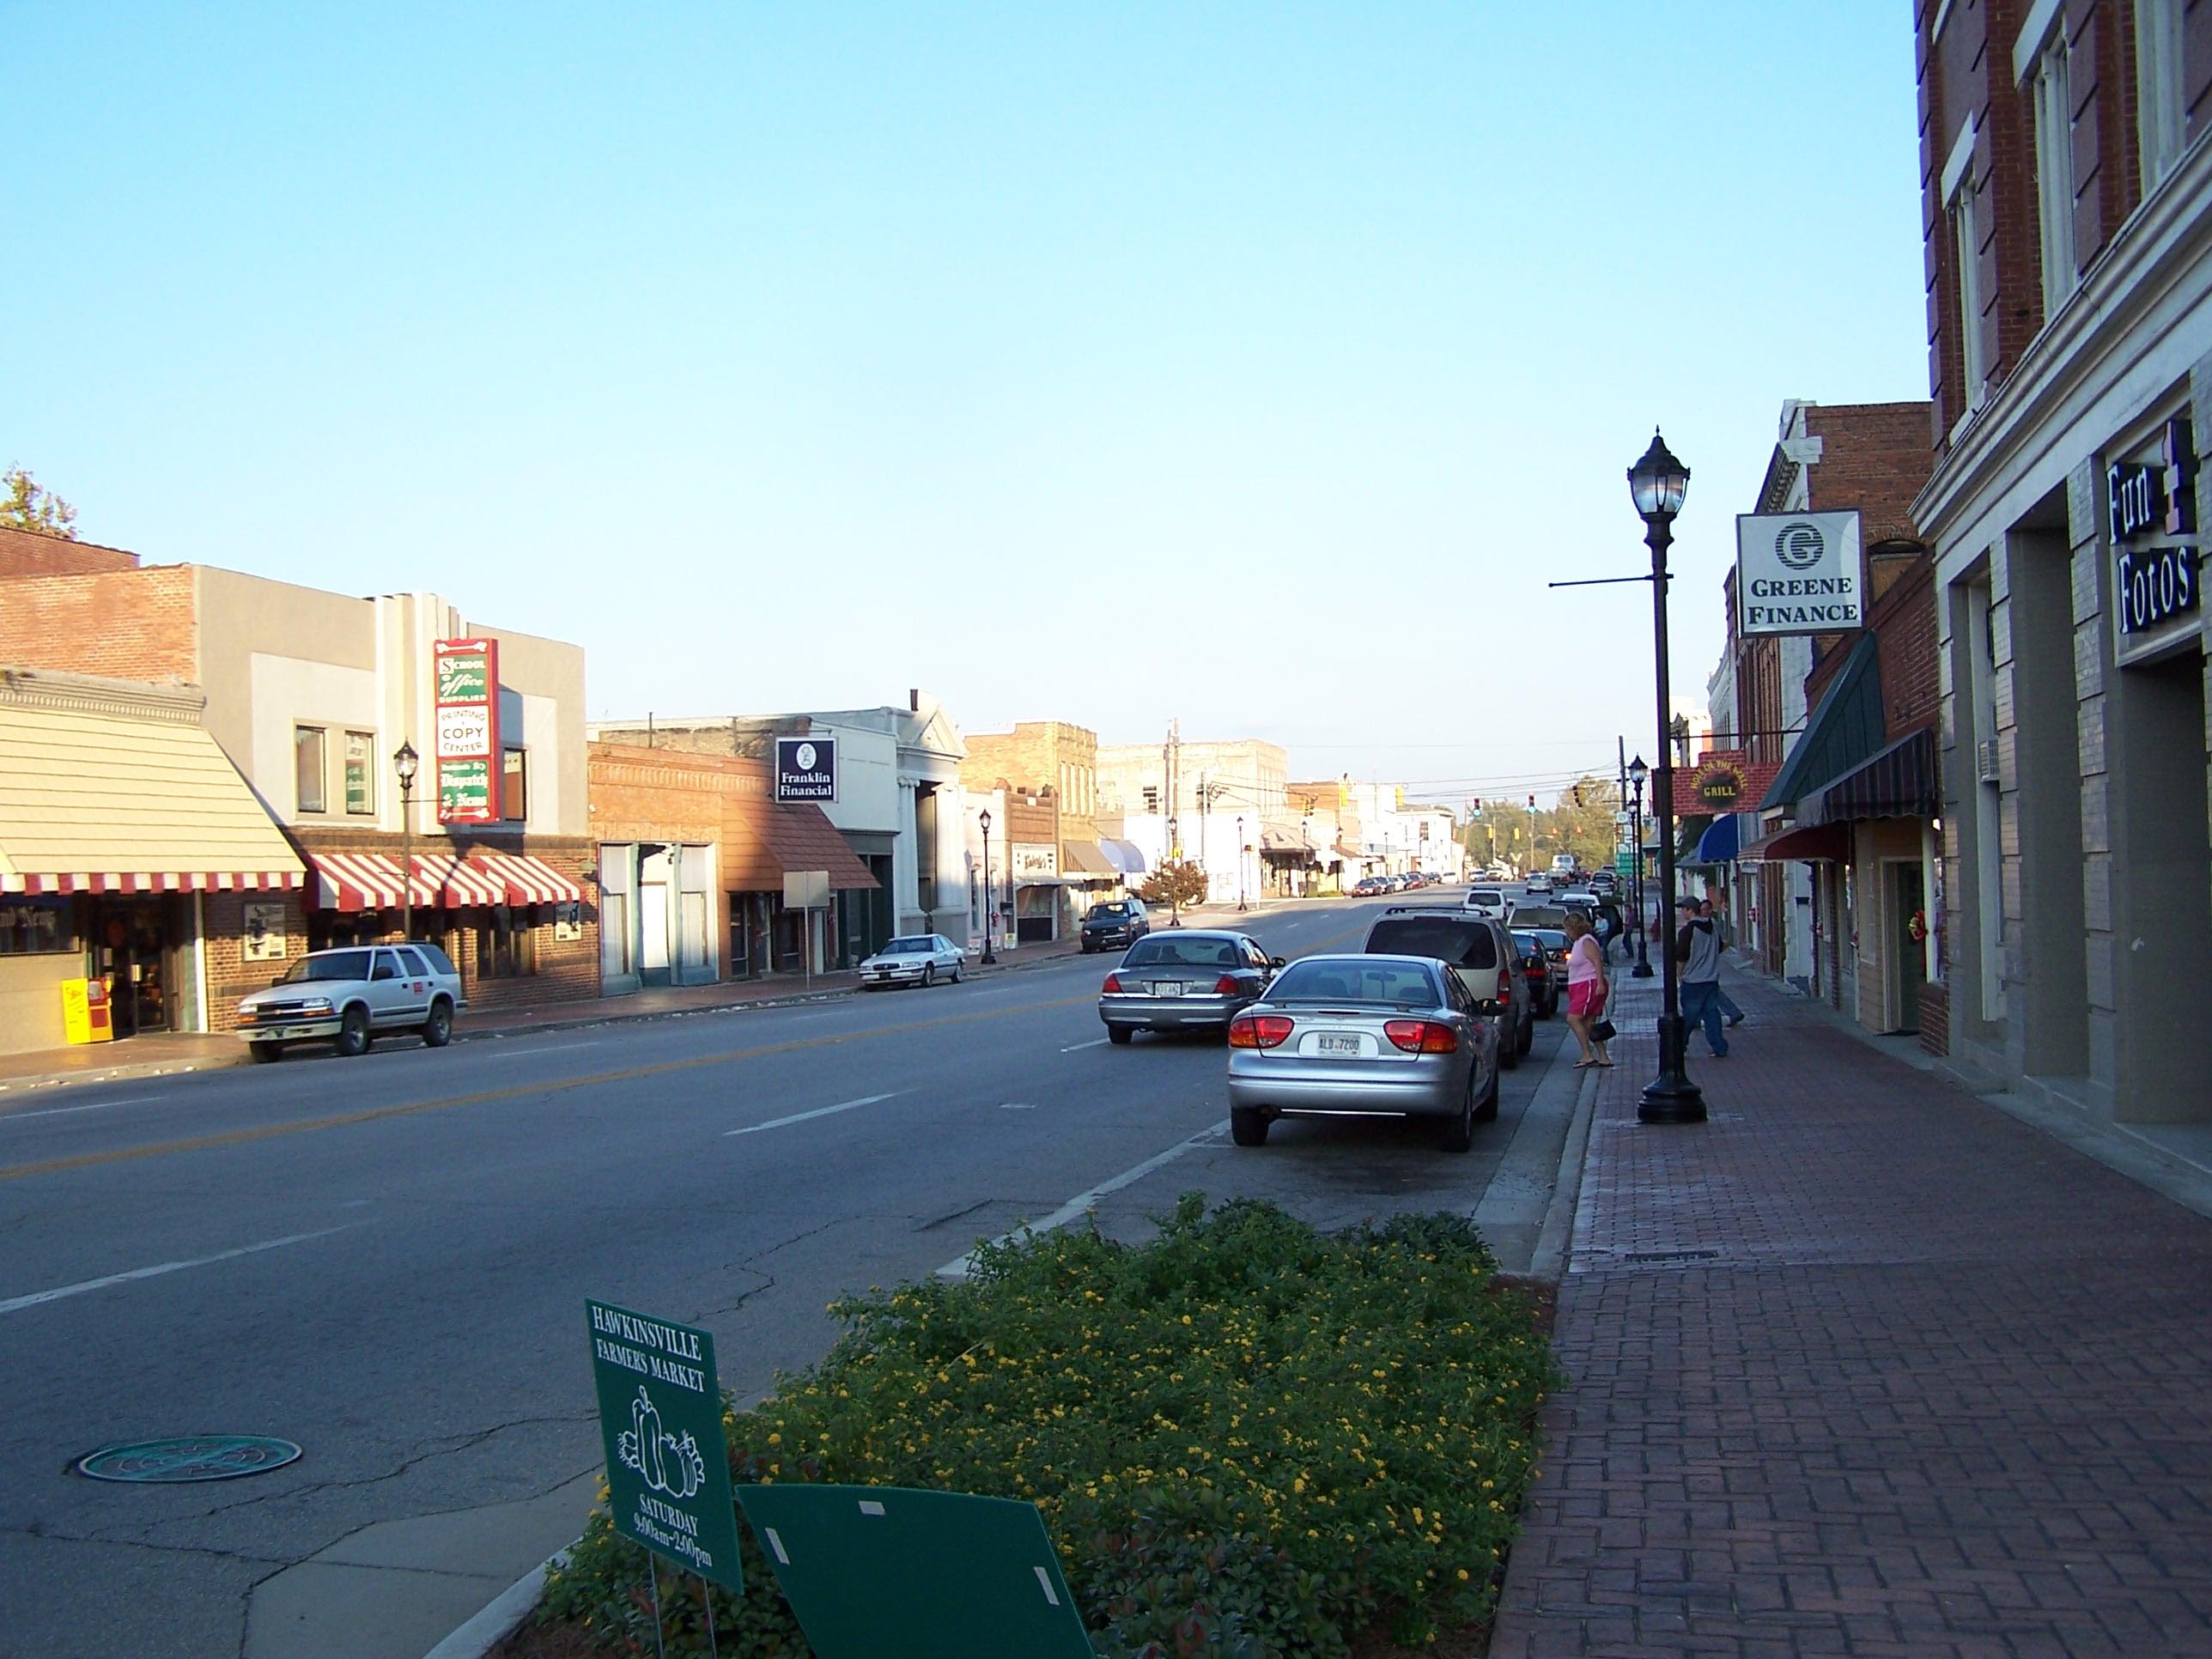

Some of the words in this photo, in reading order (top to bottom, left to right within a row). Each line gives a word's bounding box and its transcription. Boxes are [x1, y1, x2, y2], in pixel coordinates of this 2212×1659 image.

[2107, 465, 2150, 546] Fun
[1751, 578, 1852, 598] GREENE
[2118, 546, 2189, 635] Fotos
[1747, 605, 1857, 625] FINANCE
[440, 659, 486, 673] SCHOOL
[441, 710, 485, 721] PRINTING
[443, 727, 483, 739] COPY
[443, 742, 483, 752] CENTER
[781, 772, 830, 784] Franklin
[781, 785, 832, 796] Financial
[1704, 786, 1736, 797] GRILL
[1340, 1038, 1359, 1050] 7200
[592, 1305, 702, 1361] HAWKINSVILLE
[596, 1338, 648, 1374] FARMER'S
[649, 1355, 705, 1393] MARKET
[640, 1493, 698, 1537] SATURDAY
